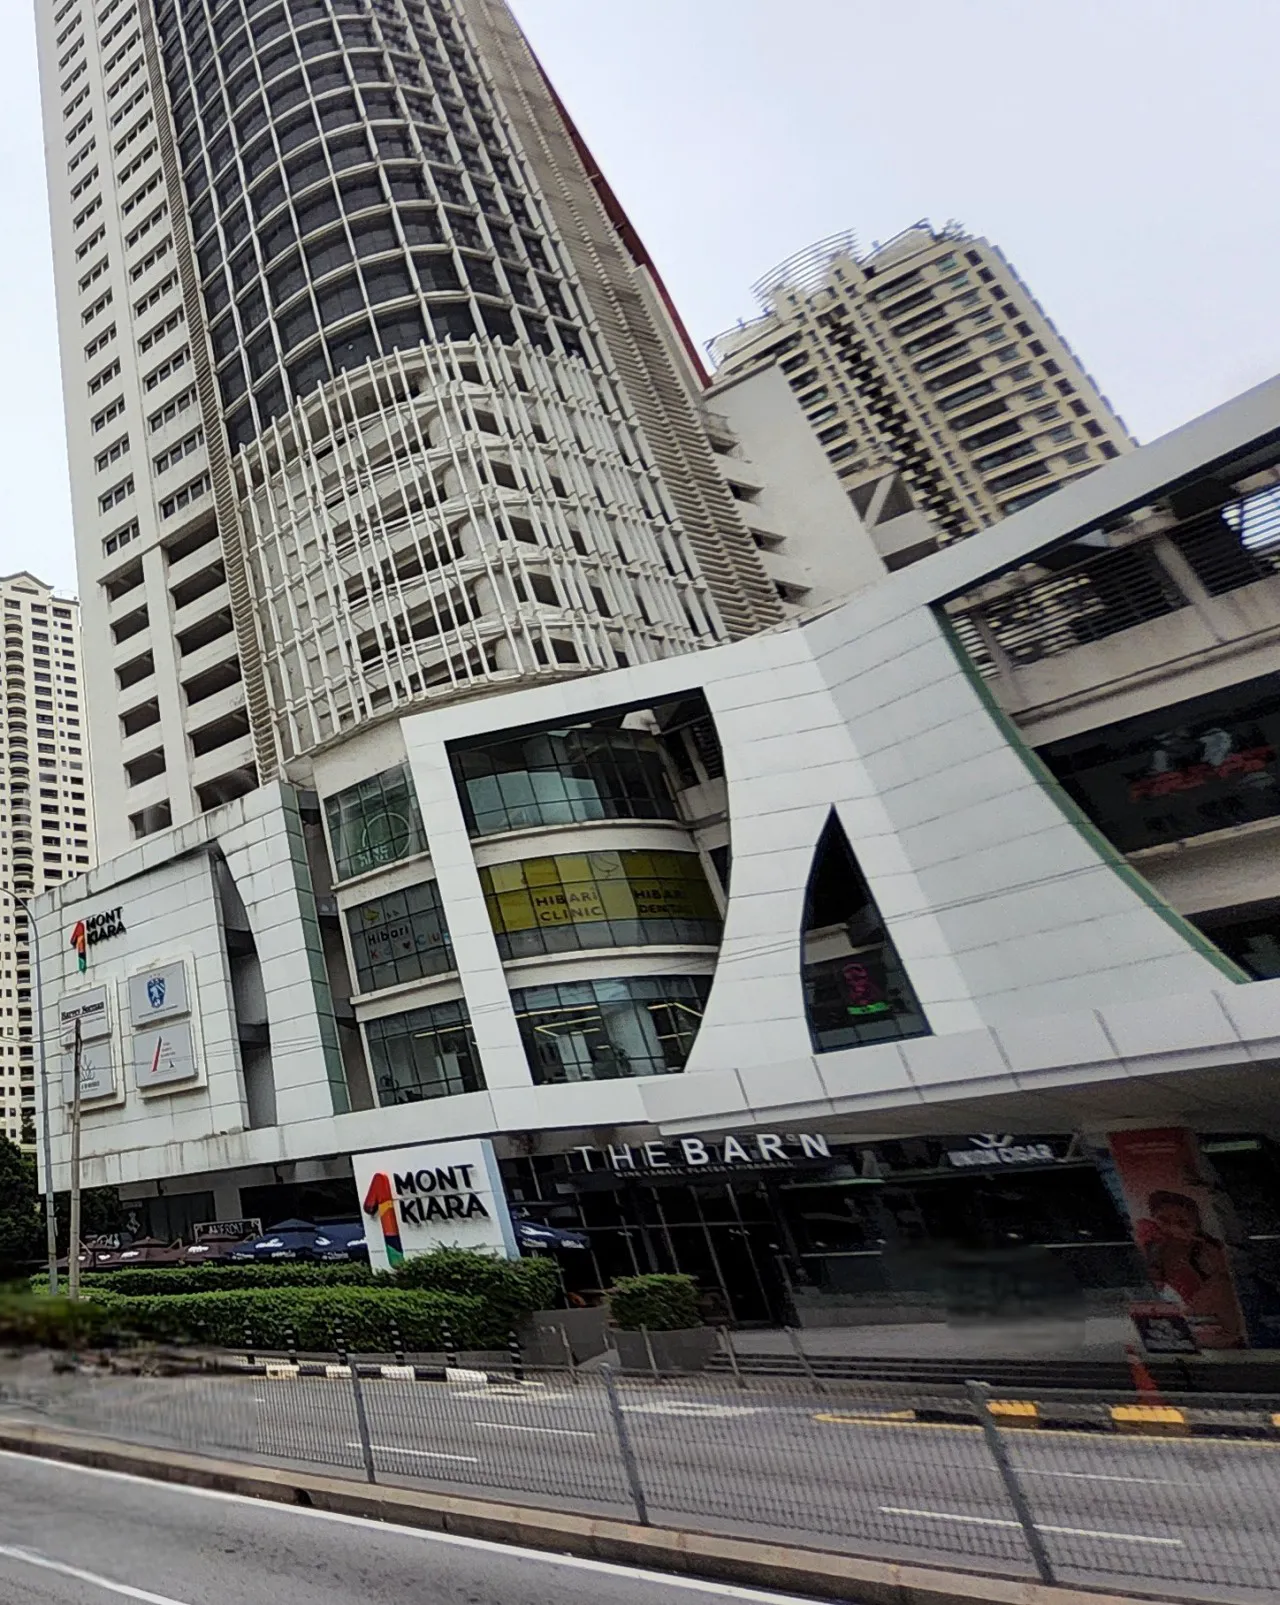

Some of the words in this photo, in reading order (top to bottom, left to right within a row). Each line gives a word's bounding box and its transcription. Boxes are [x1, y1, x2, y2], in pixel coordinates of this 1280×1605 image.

[535, 888, 599, 907] HIBARI
[85, 906, 123, 933] MONT
[538, 906, 604, 922] CLINIC
[86, 920, 127, 946] KIARA
[367, 924, 409, 946] Hibari
[573, 1140, 672, 1173] THE
[679, 1132, 833, 1167] BARN
[392, 1162, 477, 1197] MONT
[398, 1192, 490, 1225] KIARA
